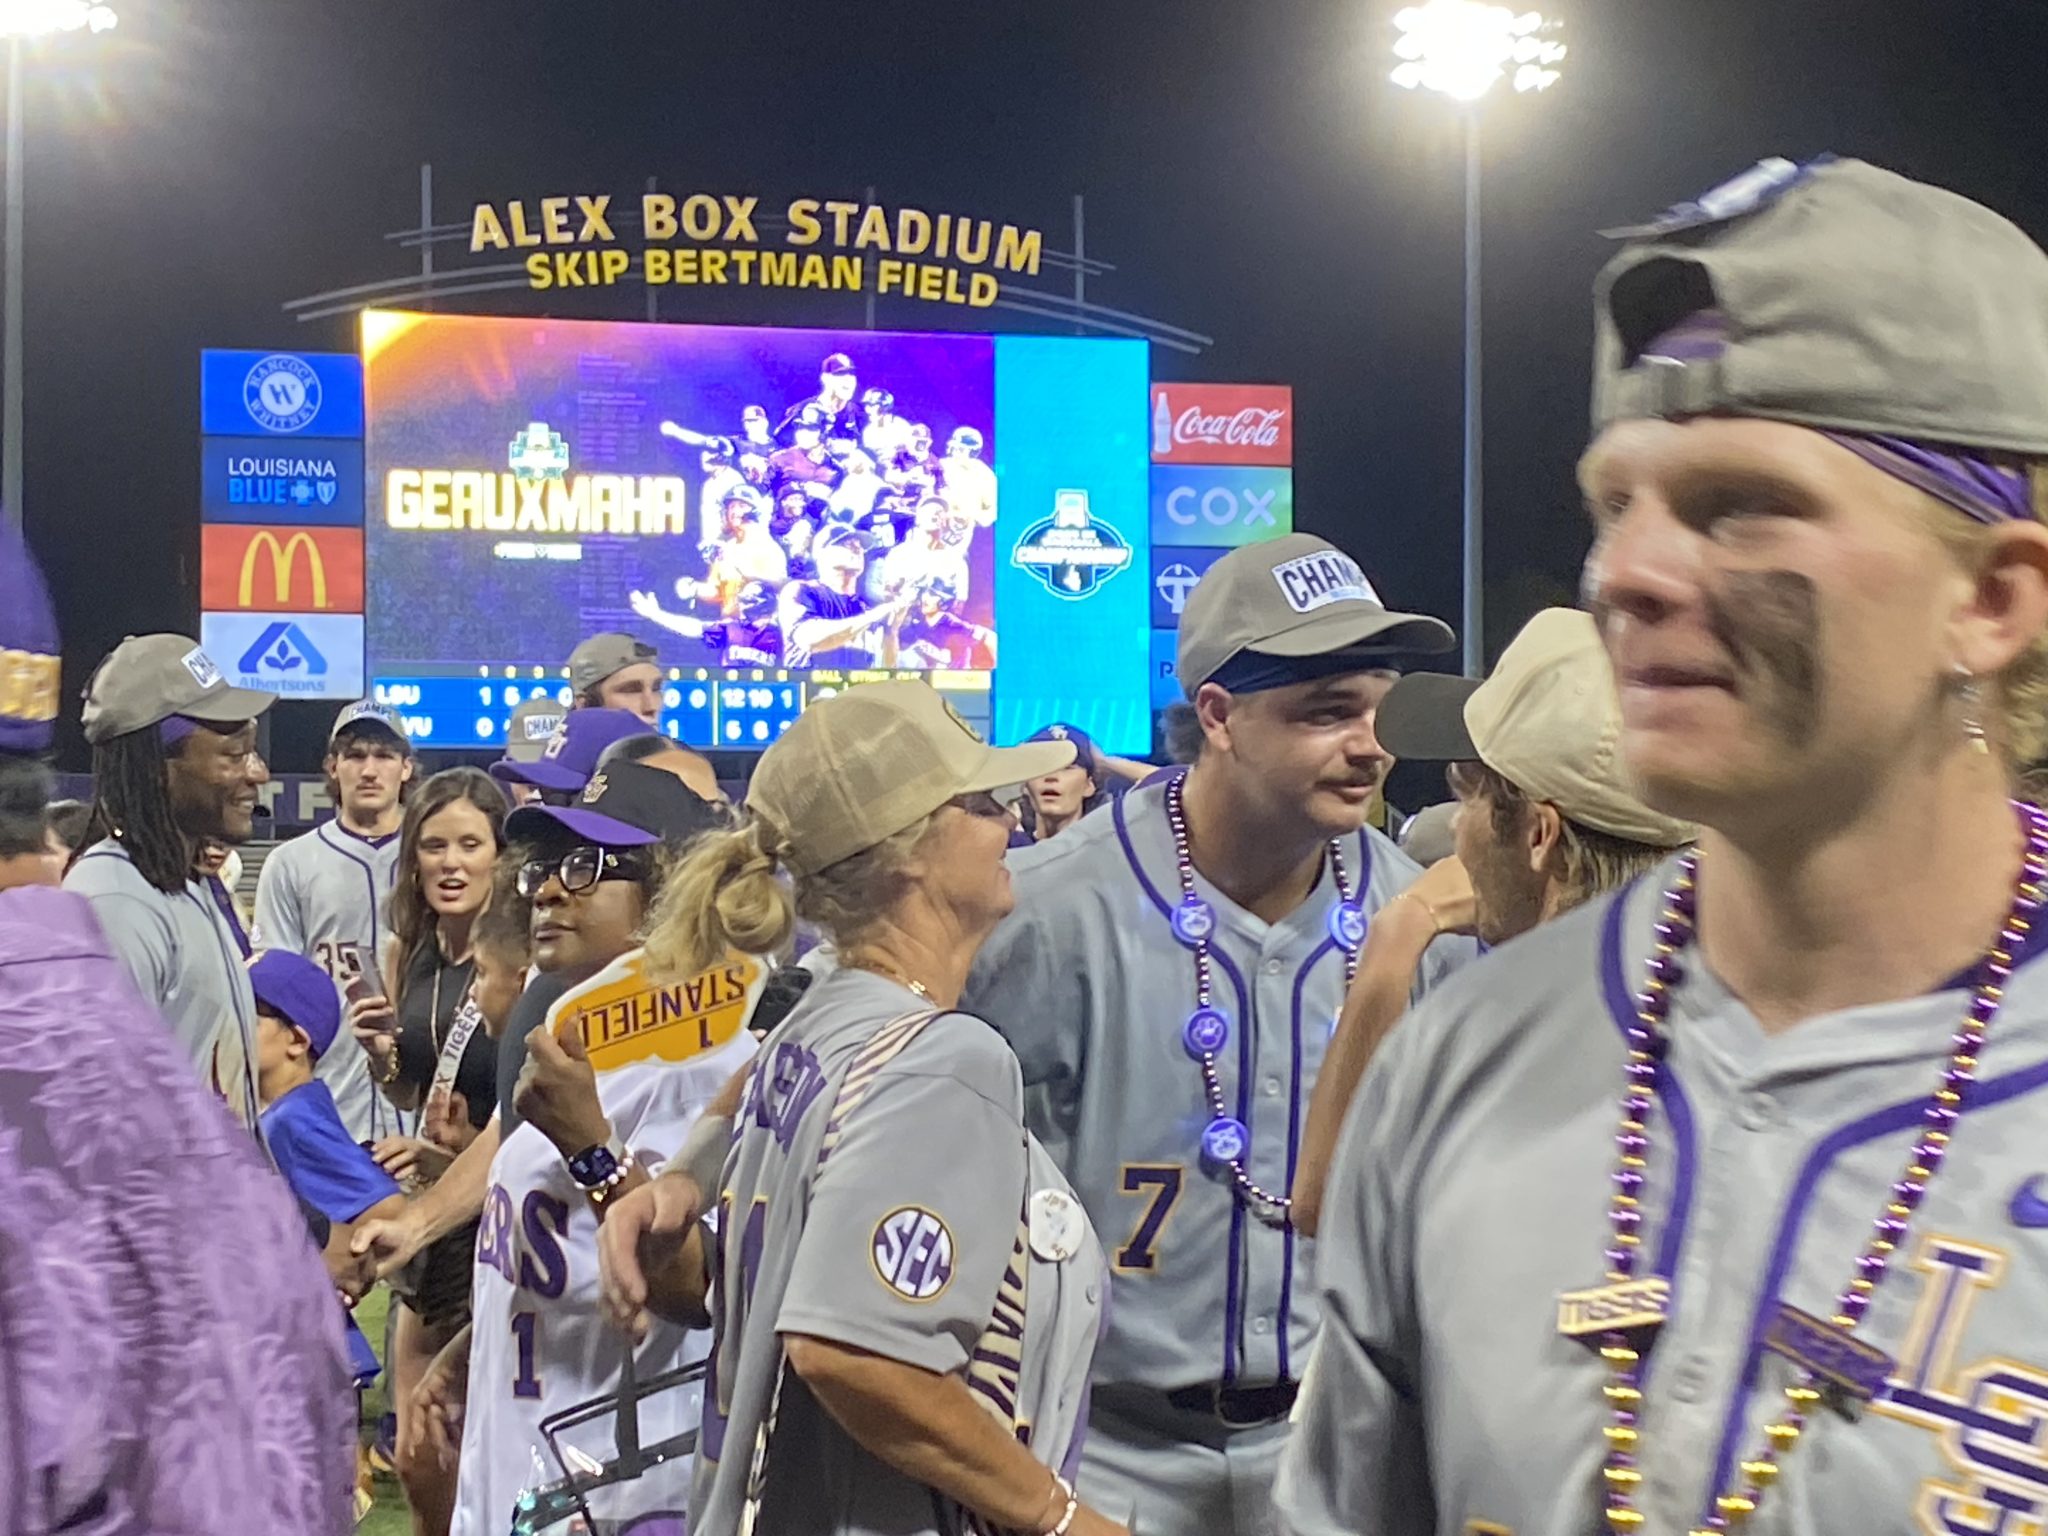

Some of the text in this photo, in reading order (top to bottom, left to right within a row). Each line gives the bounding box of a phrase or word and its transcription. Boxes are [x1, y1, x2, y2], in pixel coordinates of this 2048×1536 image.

[470, 193, 1042, 275] ALEX BOX STADIUM
[526, 248, 999, 308] SKIP BERTMAN FIELD
[250, 358, 316, 390] HANCOCK
[250, 398, 316, 428] WHITNEY
[1174, 405, 1286, 446] Coca-Cola
[228, 457, 337, 478] LOUISIANA
[229, 478, 288, 505] BLUE
[386, 468, 686, 535] GEAUXMAHA
[1166, 486, 1276, 527] COX
[1282, 555, 1366, 609] CHAM
[239, 676, 327, 692] Albertsons
[375, 684, 420, 706] LSU
[721, 688, 746, 708] 12
[781, 689, 793, 709] 1
[401, 716, 433, 737] VU
[667, 719, 679, 739] 1
[443, 1005, 478, 1060] TIGER
[1110, 1162, 1184, 1277] 7
[875, 1210, 955, 1297] SEC
[511, 1312, 542, 1399] 1
